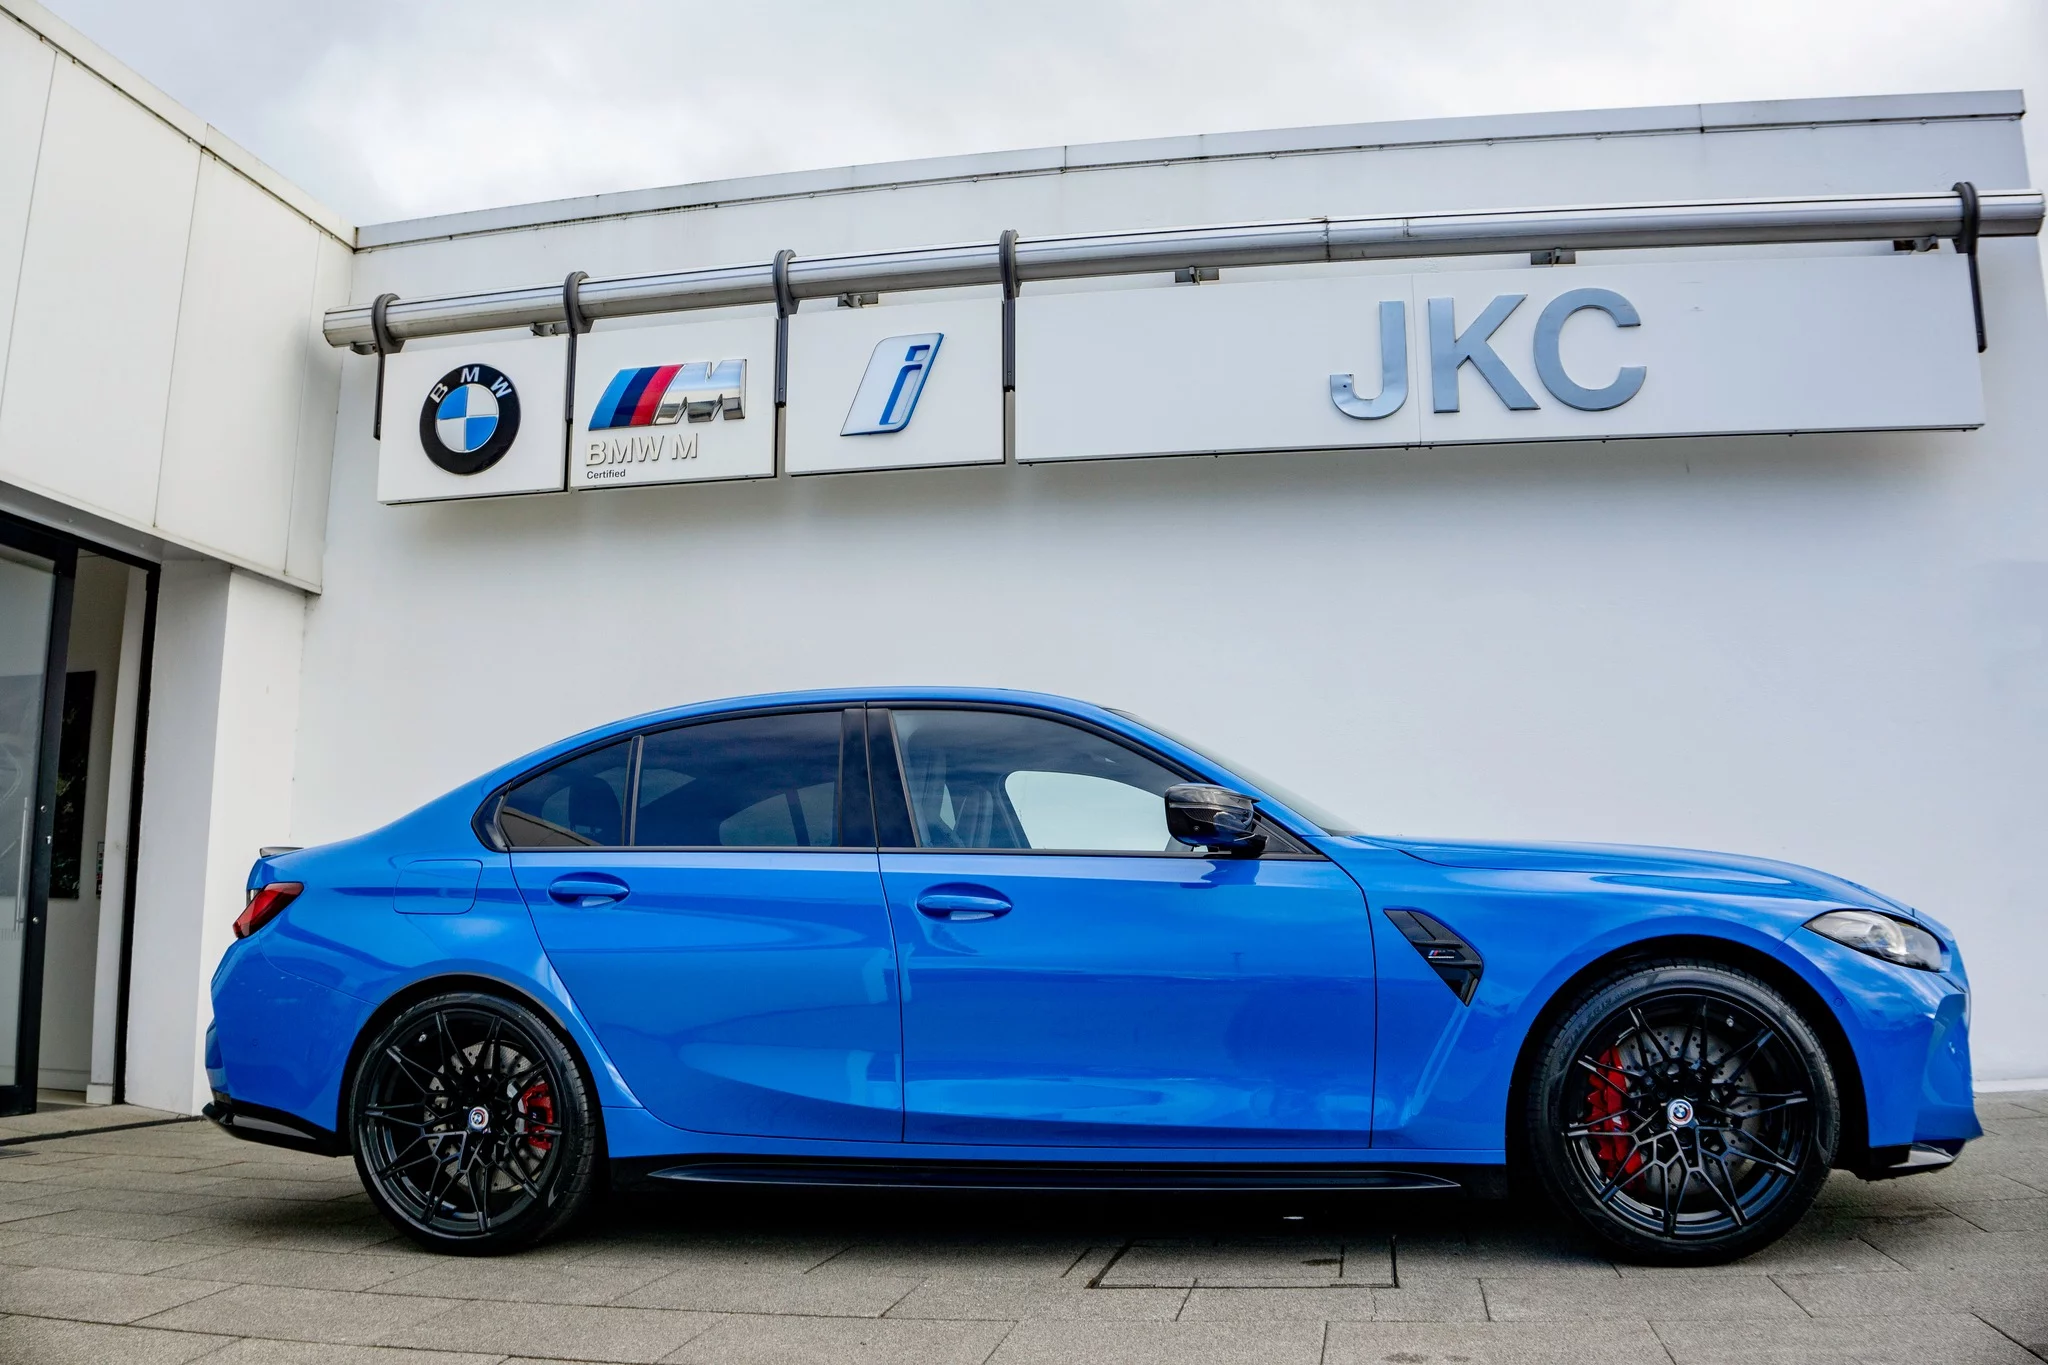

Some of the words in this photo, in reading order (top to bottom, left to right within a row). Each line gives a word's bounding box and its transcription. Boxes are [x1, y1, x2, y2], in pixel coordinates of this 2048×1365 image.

[1329, 287, 1648, 420] JKC
[429, 366, 513, 404] BMW
[586, 435, 665, 467] BMW
[671, 433, 699, 461] M
[586, 469, 627, 480] Certified
